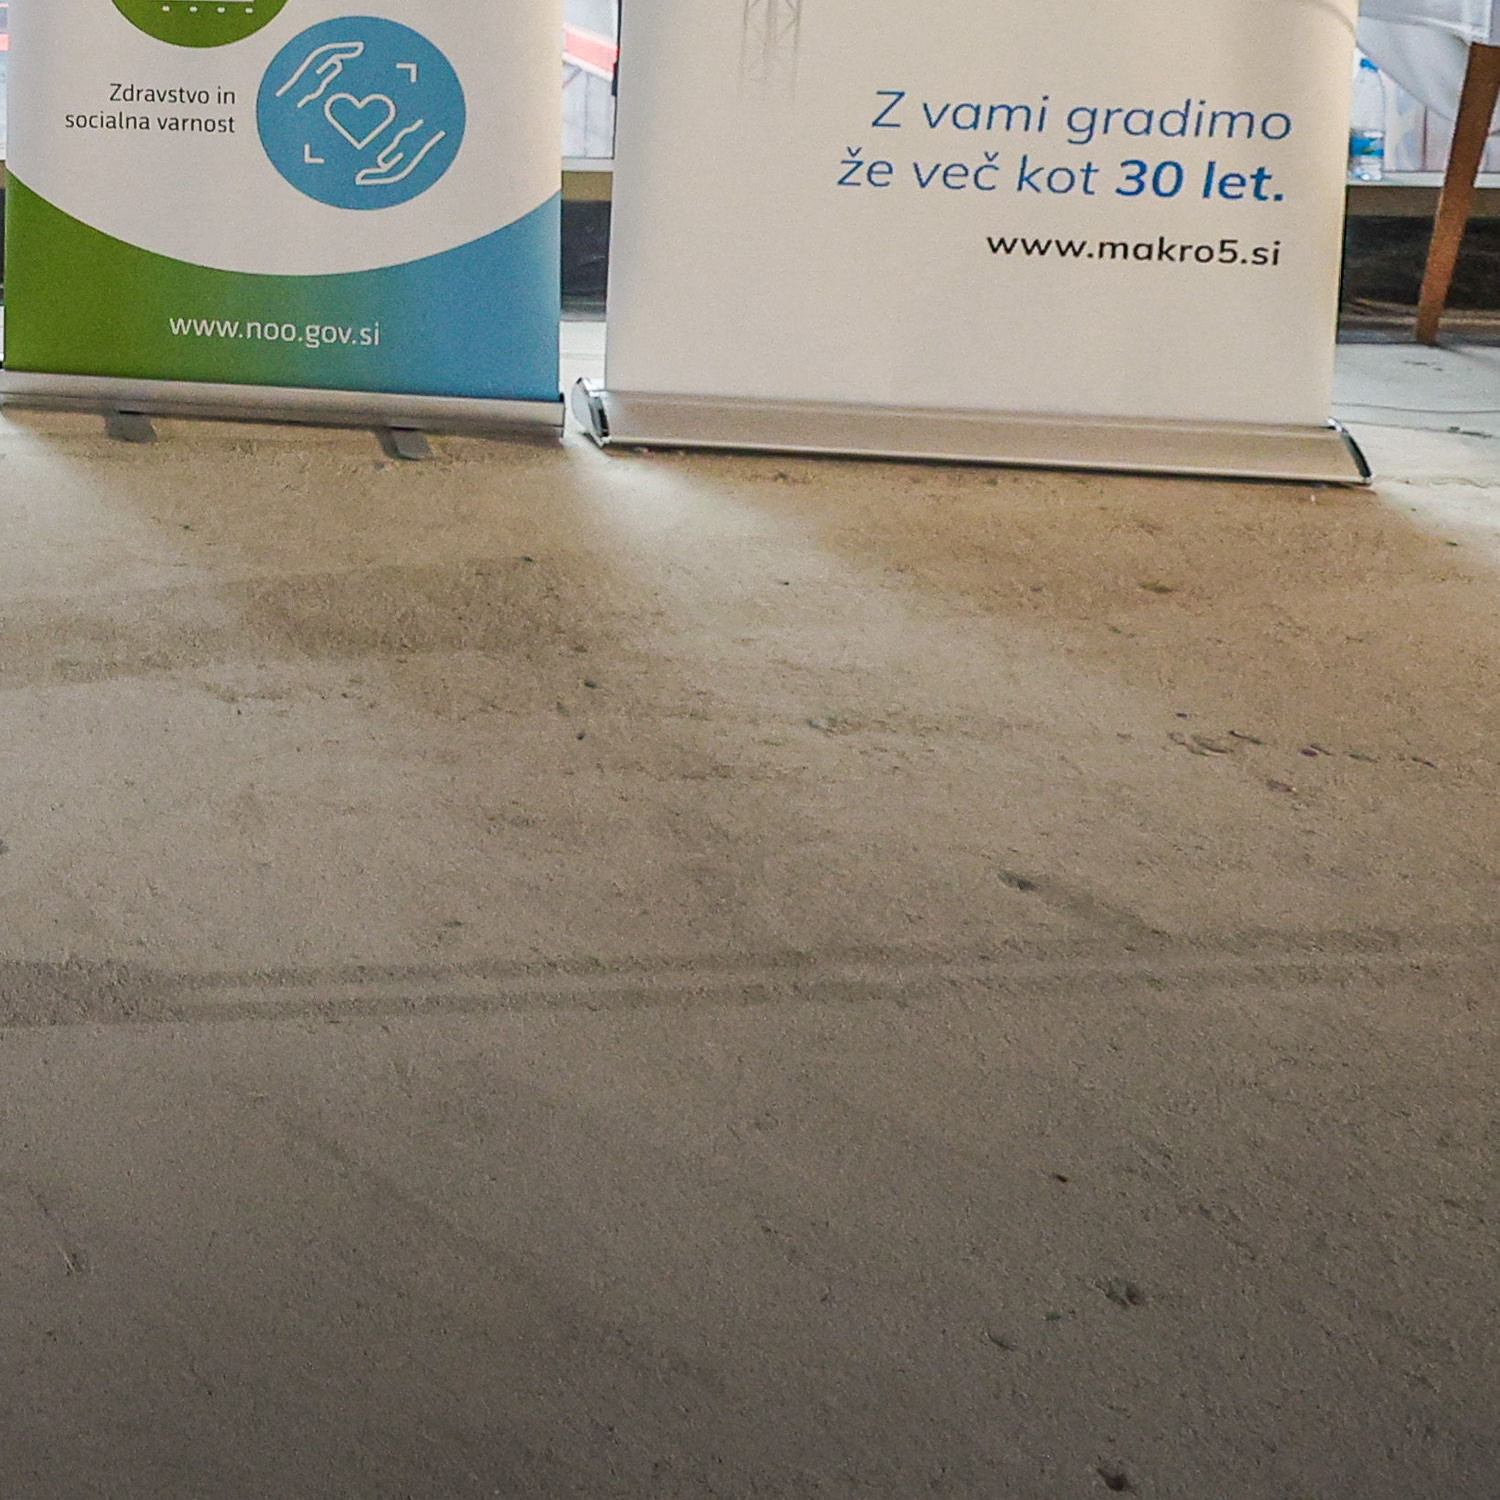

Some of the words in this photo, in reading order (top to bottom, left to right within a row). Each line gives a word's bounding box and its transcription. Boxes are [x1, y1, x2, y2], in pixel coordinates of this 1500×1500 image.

[109, 83, 211, 105] Zdravstvo
[217, 85, 236, 105] in
[65, 111, 151, 131] socialna
[157, 115, 236, 134] varnost
[870, 90, 906, 129] Z
[922, 94, 1049, 134] vami
[1067, 99, 1293, 146] gradimo
[836, 147, 894, 189] že
[913, 150, 1000, 191] več
[1017, 154, 1100, 196] kot
[1115, 159, 1184, 199] 30
[1201, 159, 1285, 203] let.
[987, 235, 1281, 267] www.makro5.si
[169, 315, 380, 349] www.noo.gov.si
